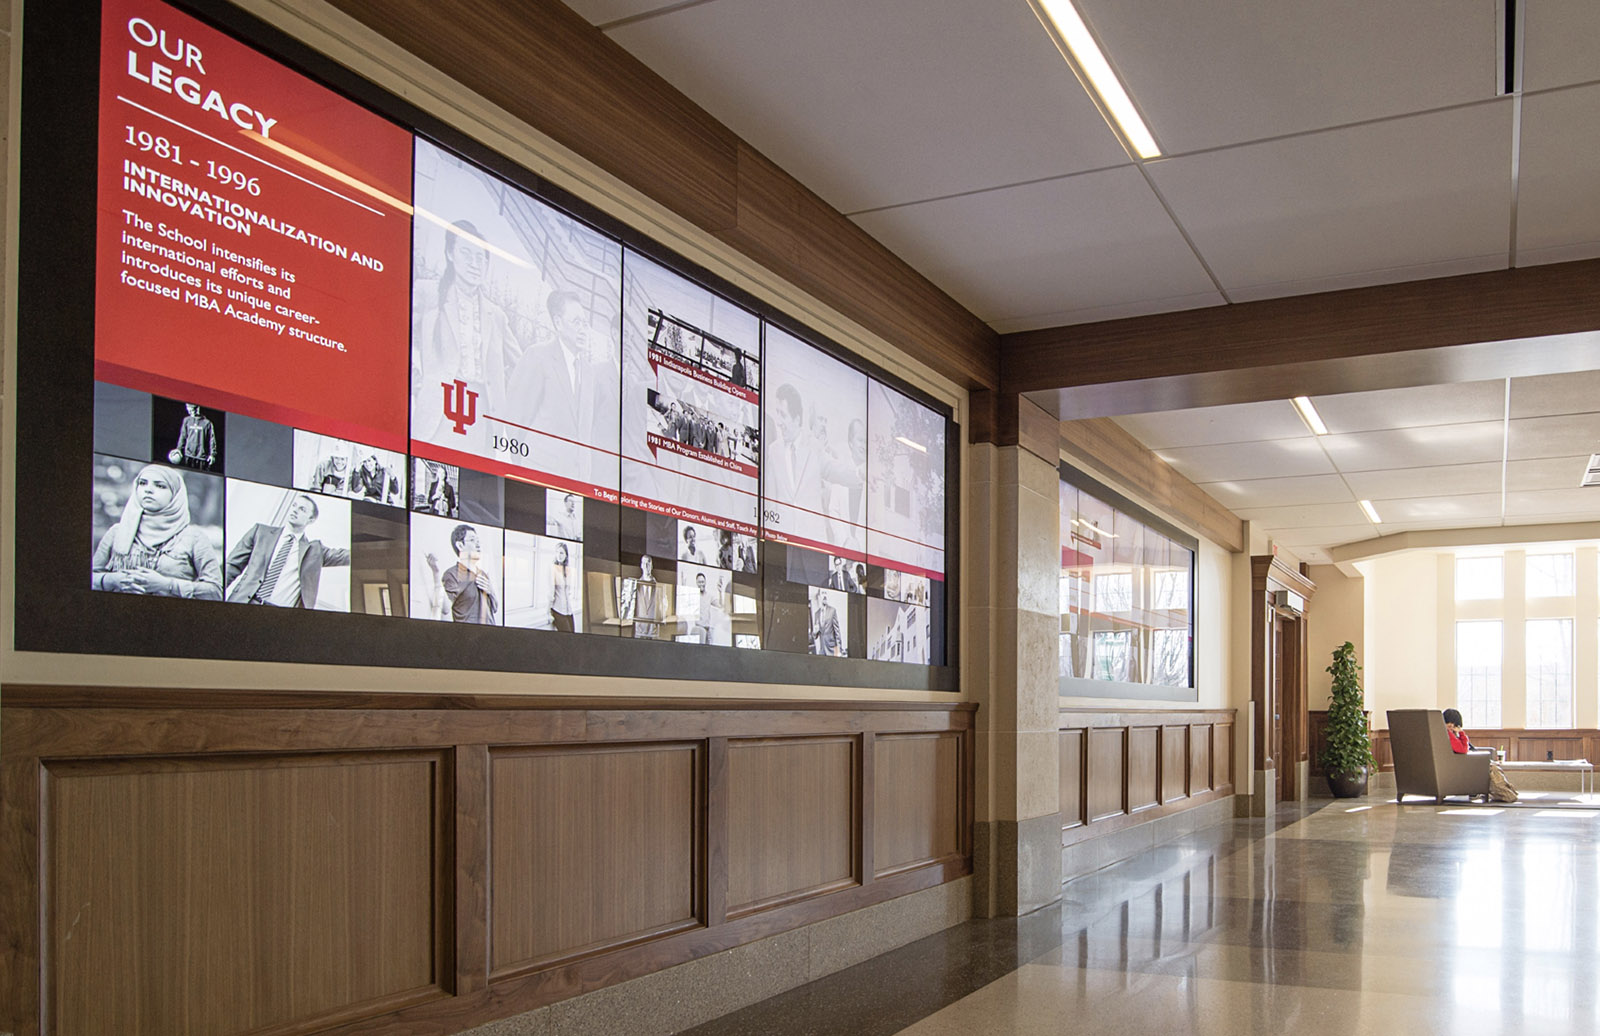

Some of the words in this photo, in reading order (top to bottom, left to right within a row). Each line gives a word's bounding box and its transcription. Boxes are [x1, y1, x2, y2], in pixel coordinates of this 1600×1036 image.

[128, 17, 206, 75] OUR
[128, 50, 277, 138] LEGACY
[125, 125, 183, 165] 1981
[206, 160, 261, 197] 1996
[123, 176, 251, 236] INNOVATION
[123, 159, 348, 259] INTERNATIONALIZATION
[350, 251, 384, 272] AND
[122, 209, 153, 232] The
[158, 223, 207, 251] School
[211, 242, 277, 276] intensifies
[281, 268, 296, 283] its
[122, 230, 216, 274] international
[220, 267, 264, 290] efforts
[267, 284, 291, 299] and
[120, 270, 180, 300] focused
[185, 290, 221, 313] MBA
[224, 304, 285, 335] Academy
[288, 327, 347, 352] structure.
[121, 250, 202, 288] introduces
[206, 279, 223, 295] its
[227, 288, 272, 311] unique
[275, 304, 320, 325] career-
[648, 351, 663, 363] 1981
[663, 358, 693, 377] Indianapolis
[692, 369, 713, 385] Business
[713, 378, 732, 394] Building
[731, 387, 747, 399] Opens
[492, 435, 530, 458] 1980
[647, 434, 661, 446] 1981
[662, 439, 676, 451] MBA
[676, 444, 698, 457] Program
[697, 451, 725, 466] Established
[729, 462, 743, 472] China
[594, 488, 602, 497] To
[603, 490, 618, 502] Begin
[621, 496, 639, 508] ploring
[638, 501, 648, 509] the
[648, 501, 665, 513] Stories
[671, 508, 682, 516] Our
[753, 506, 780, 524] 1982
